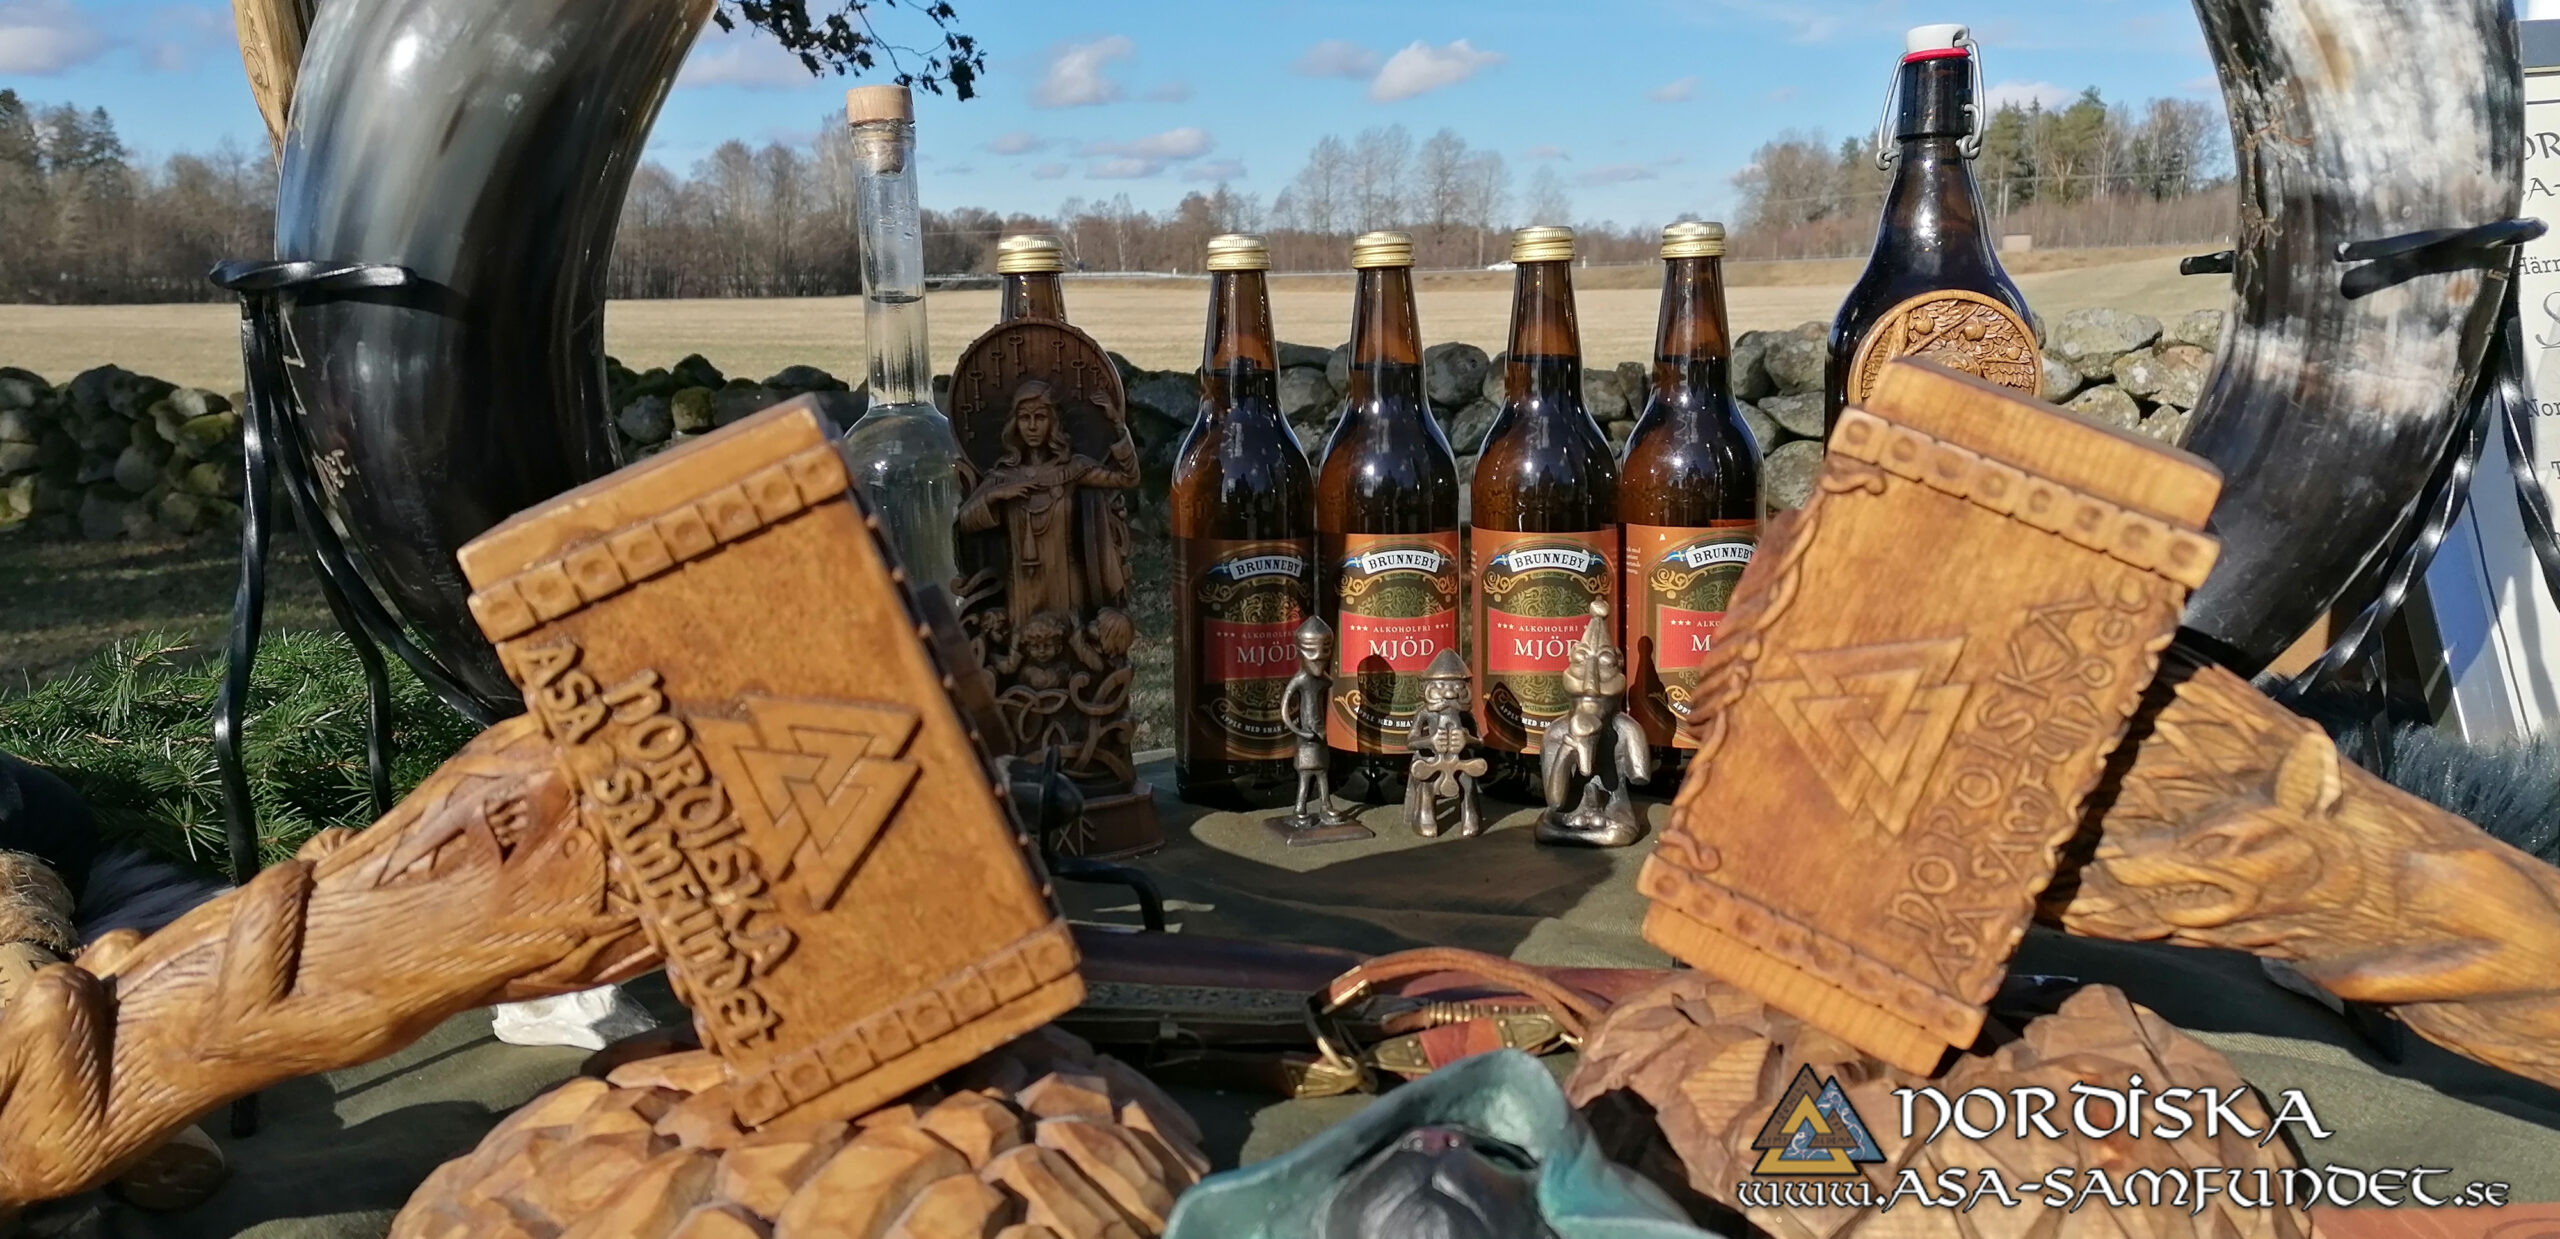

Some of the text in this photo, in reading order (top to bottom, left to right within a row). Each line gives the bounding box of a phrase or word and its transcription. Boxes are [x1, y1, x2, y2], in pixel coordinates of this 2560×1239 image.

[1235, 556, 1300, 576] BRUNNEBY
[1369, 554, 1436, 572] BRUNNEBY
[1514, 553, 1585, 568] BRUNNEBY
[1373, 625, 1431, 633] ALKOHOLFRI
[1518, 624, 1578, 632] ALKOHOLFRI
[1236, 641, 1298, 666] MJÖD
[1369, 635, 1434, 660] MJÖD
[522, 640, 608, 743] ASA
[602, 668, 798, 977] NORDISKA
